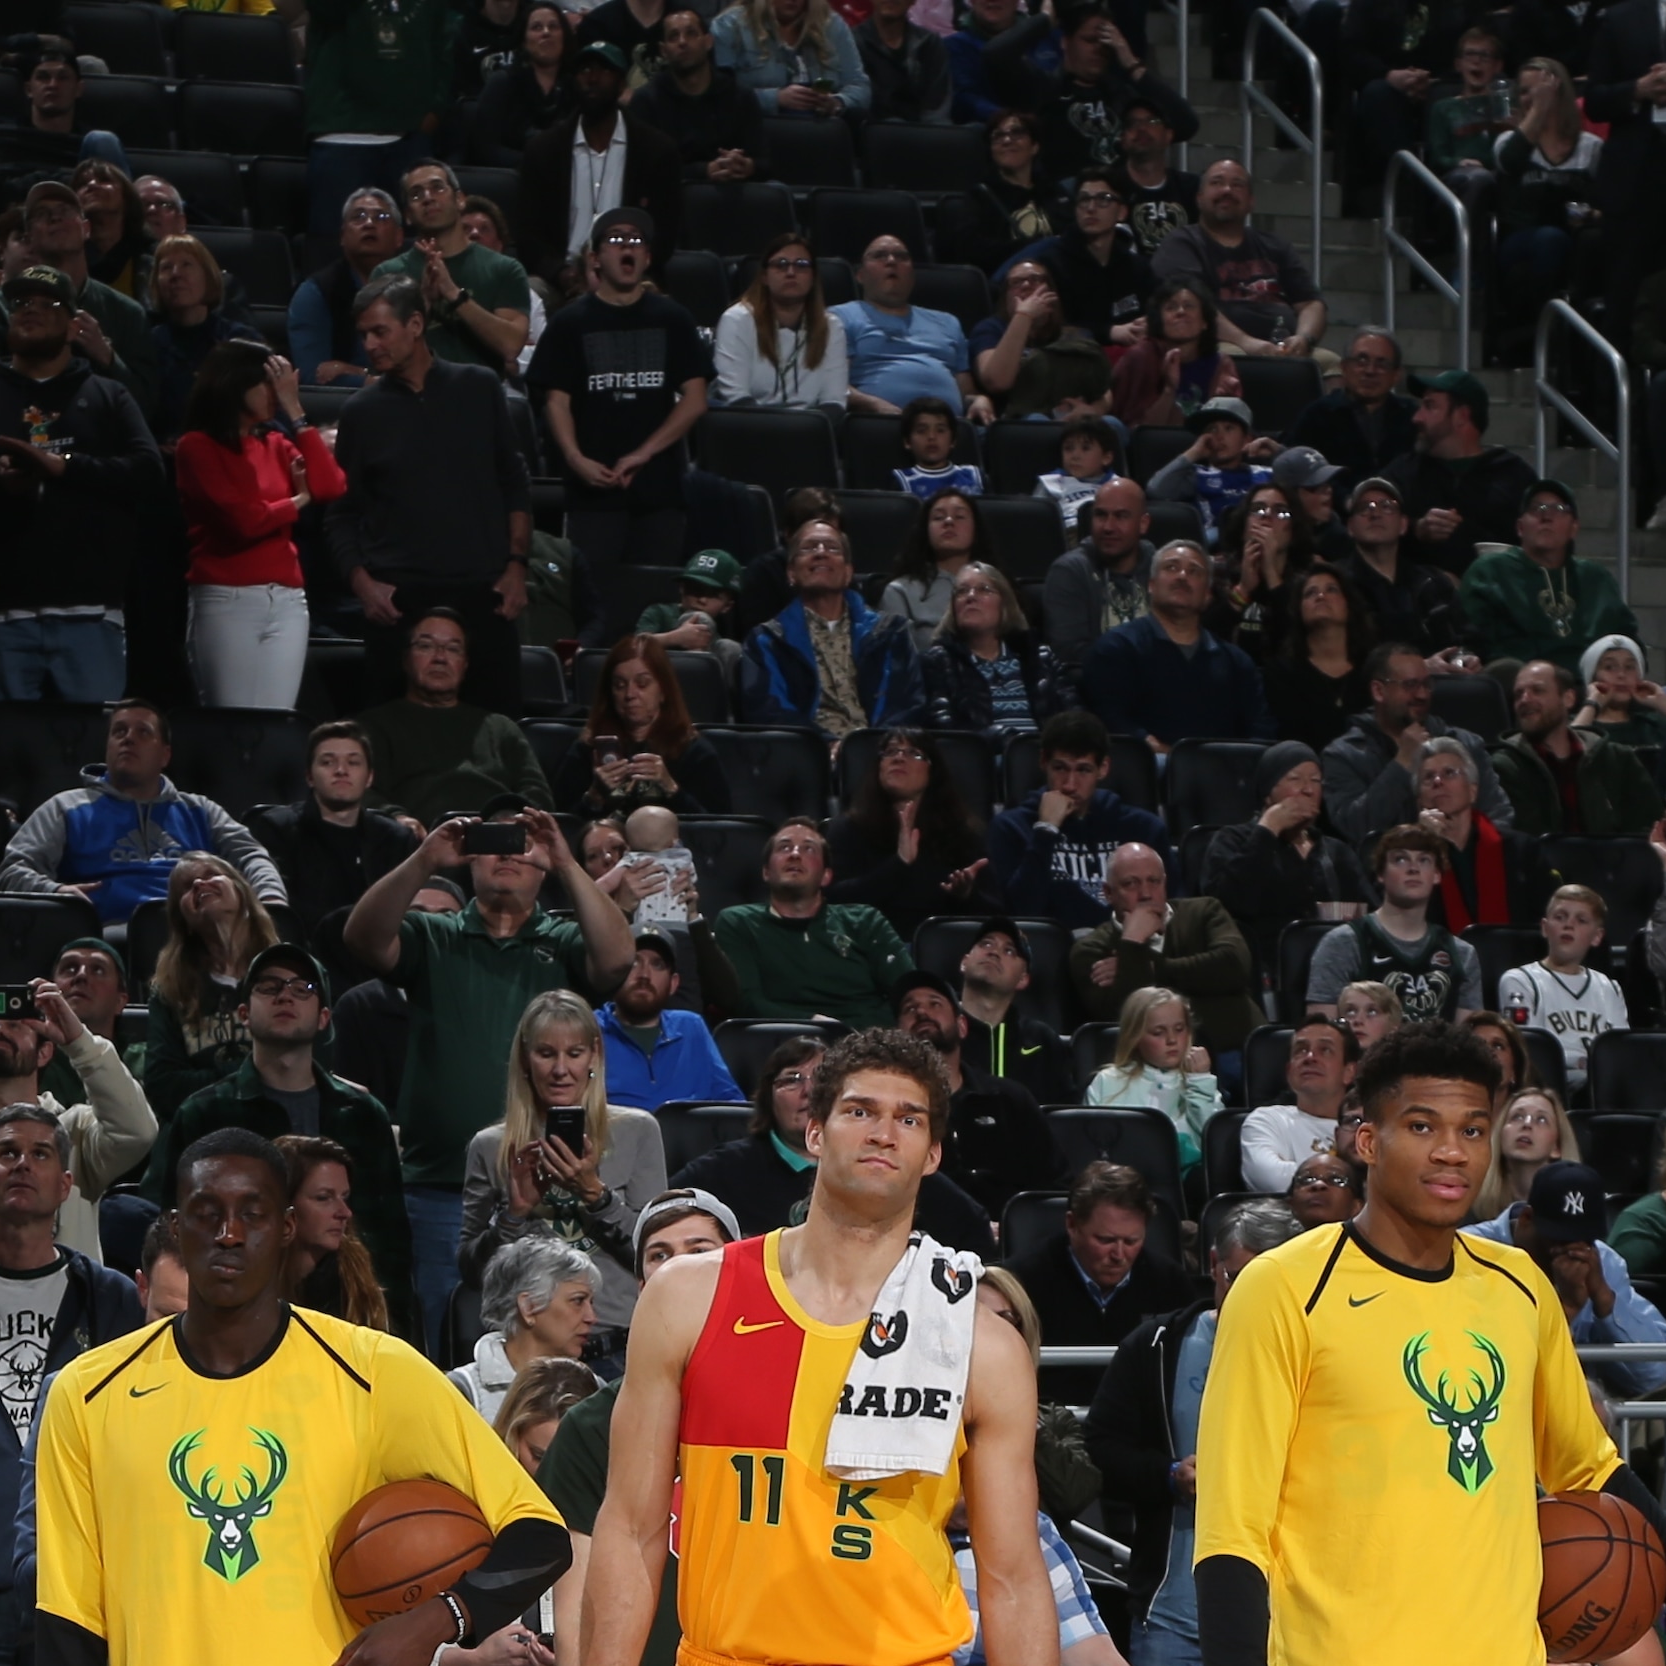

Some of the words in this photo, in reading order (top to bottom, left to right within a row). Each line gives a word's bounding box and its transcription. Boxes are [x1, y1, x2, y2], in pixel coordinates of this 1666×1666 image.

[1084, 100, 1106, 119] 34
[1147, 201, 1168, 220] 34
[615, 373, 636, 388] THE
[637, 371, 665, 388] DEER
[698, 555, 718, 568] 50
[1400, 972, 1431, 995] 34
[838, 1384, 952, 1421] RADE
[729, 1453, 785, 1526] 11
